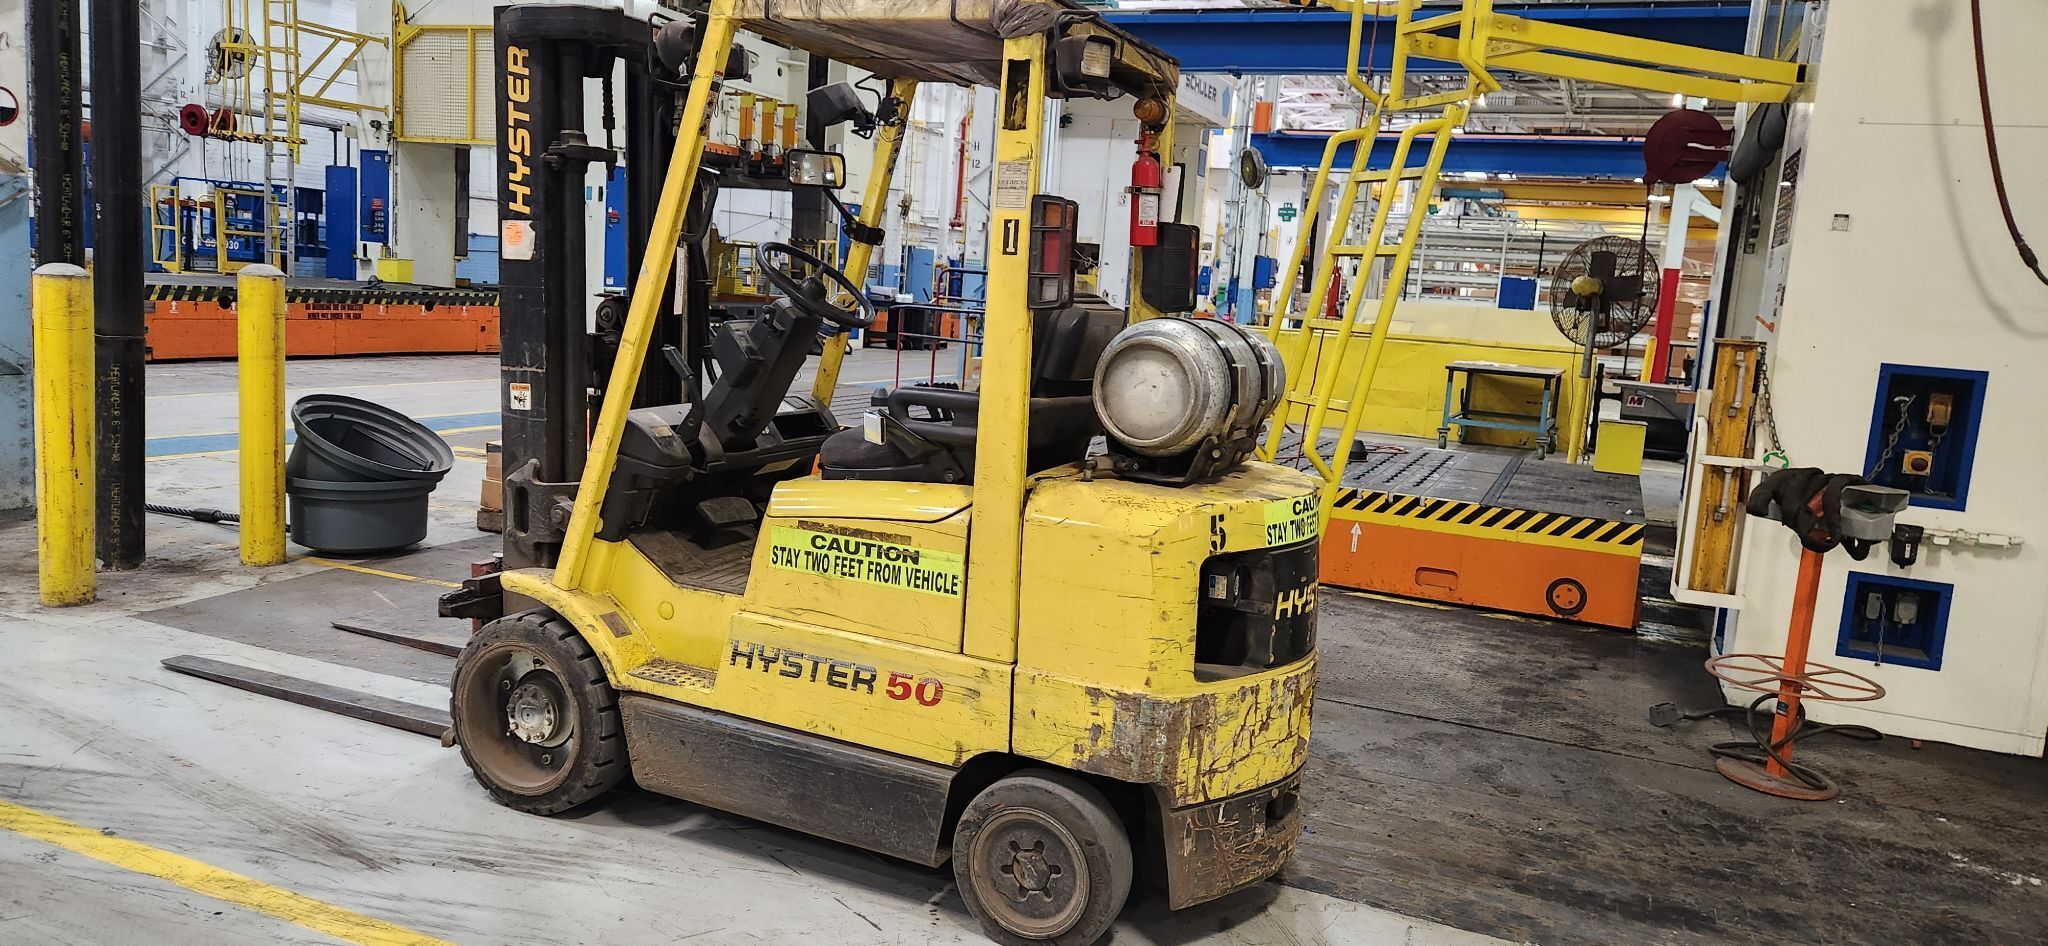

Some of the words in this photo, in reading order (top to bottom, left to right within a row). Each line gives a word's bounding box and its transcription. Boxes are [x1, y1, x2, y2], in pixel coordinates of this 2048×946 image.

[507, 46, 531, 215] HYSTER
[972, 159, 981, 168] 12
[1006, 219, 1016, 253] 1
[1209, 513, 1227, 552] 5
[1266, 520, 1288, 546] STAY
[1290, 516, 1305, 540] TWO
[810, 534, 920, 566] CAUTION
[771, 545, 801, 569] STAY
[803, 550, 830, 574] TWO
[833, 555, 864, 579] FEET
[867, 560, 902, 586] FROM
[905, 566, 959, 596] VEHICLE
[729, 639, 877, 695] HYSTER
[885, 671, 945, 707] 50
